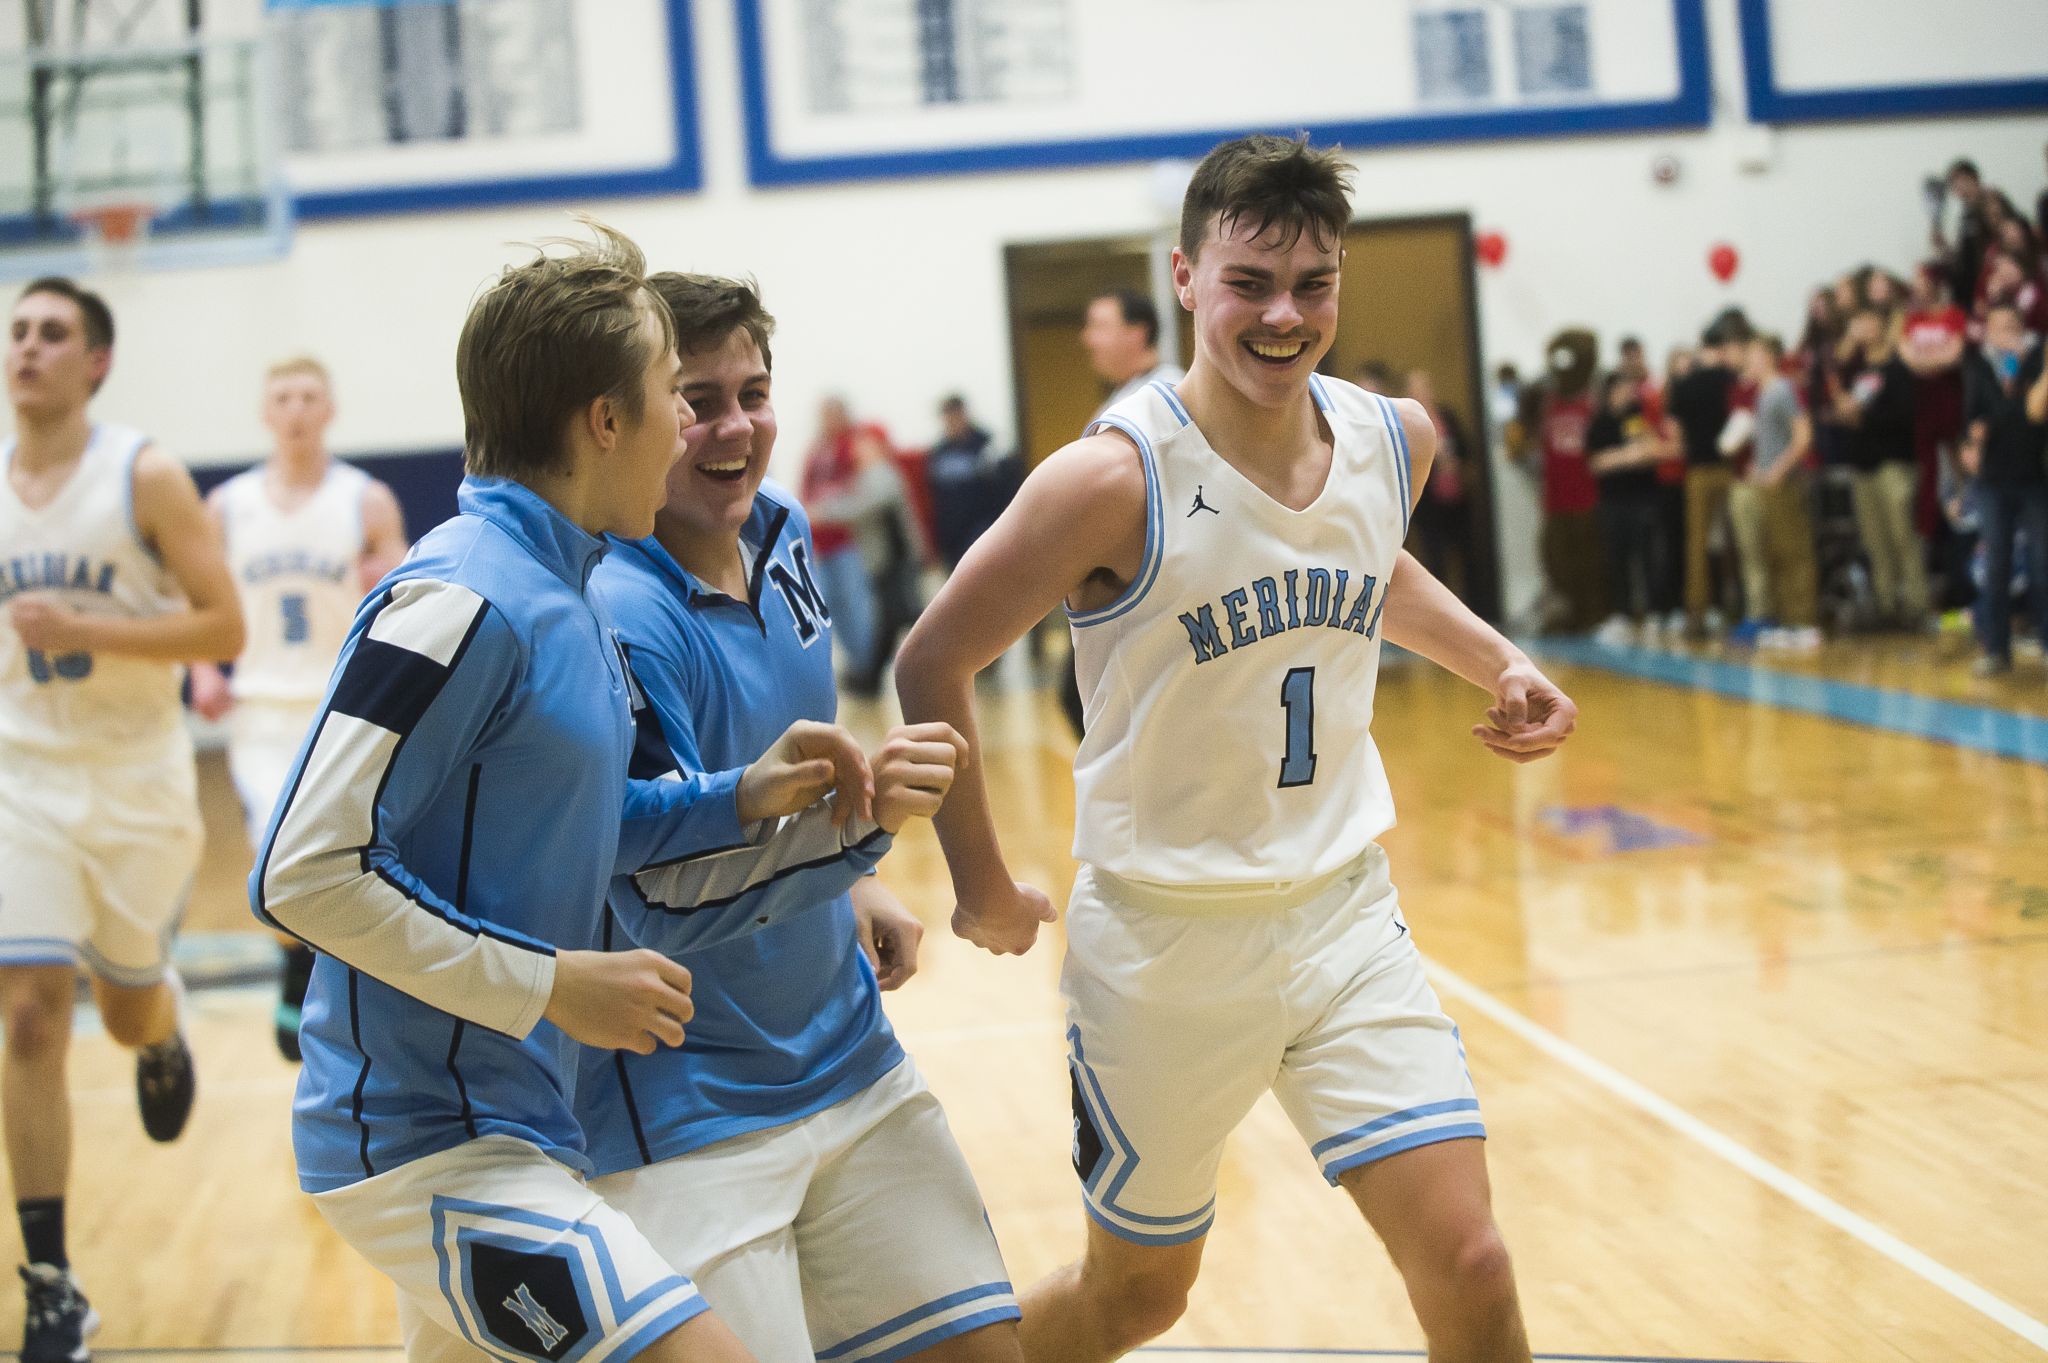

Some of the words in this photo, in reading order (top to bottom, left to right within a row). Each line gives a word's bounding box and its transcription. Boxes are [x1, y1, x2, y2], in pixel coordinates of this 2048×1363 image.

[765, 537, 832, 650] M
[1277, 666, 1317, 788] 1
[502, 1283, 568, 1352] M
